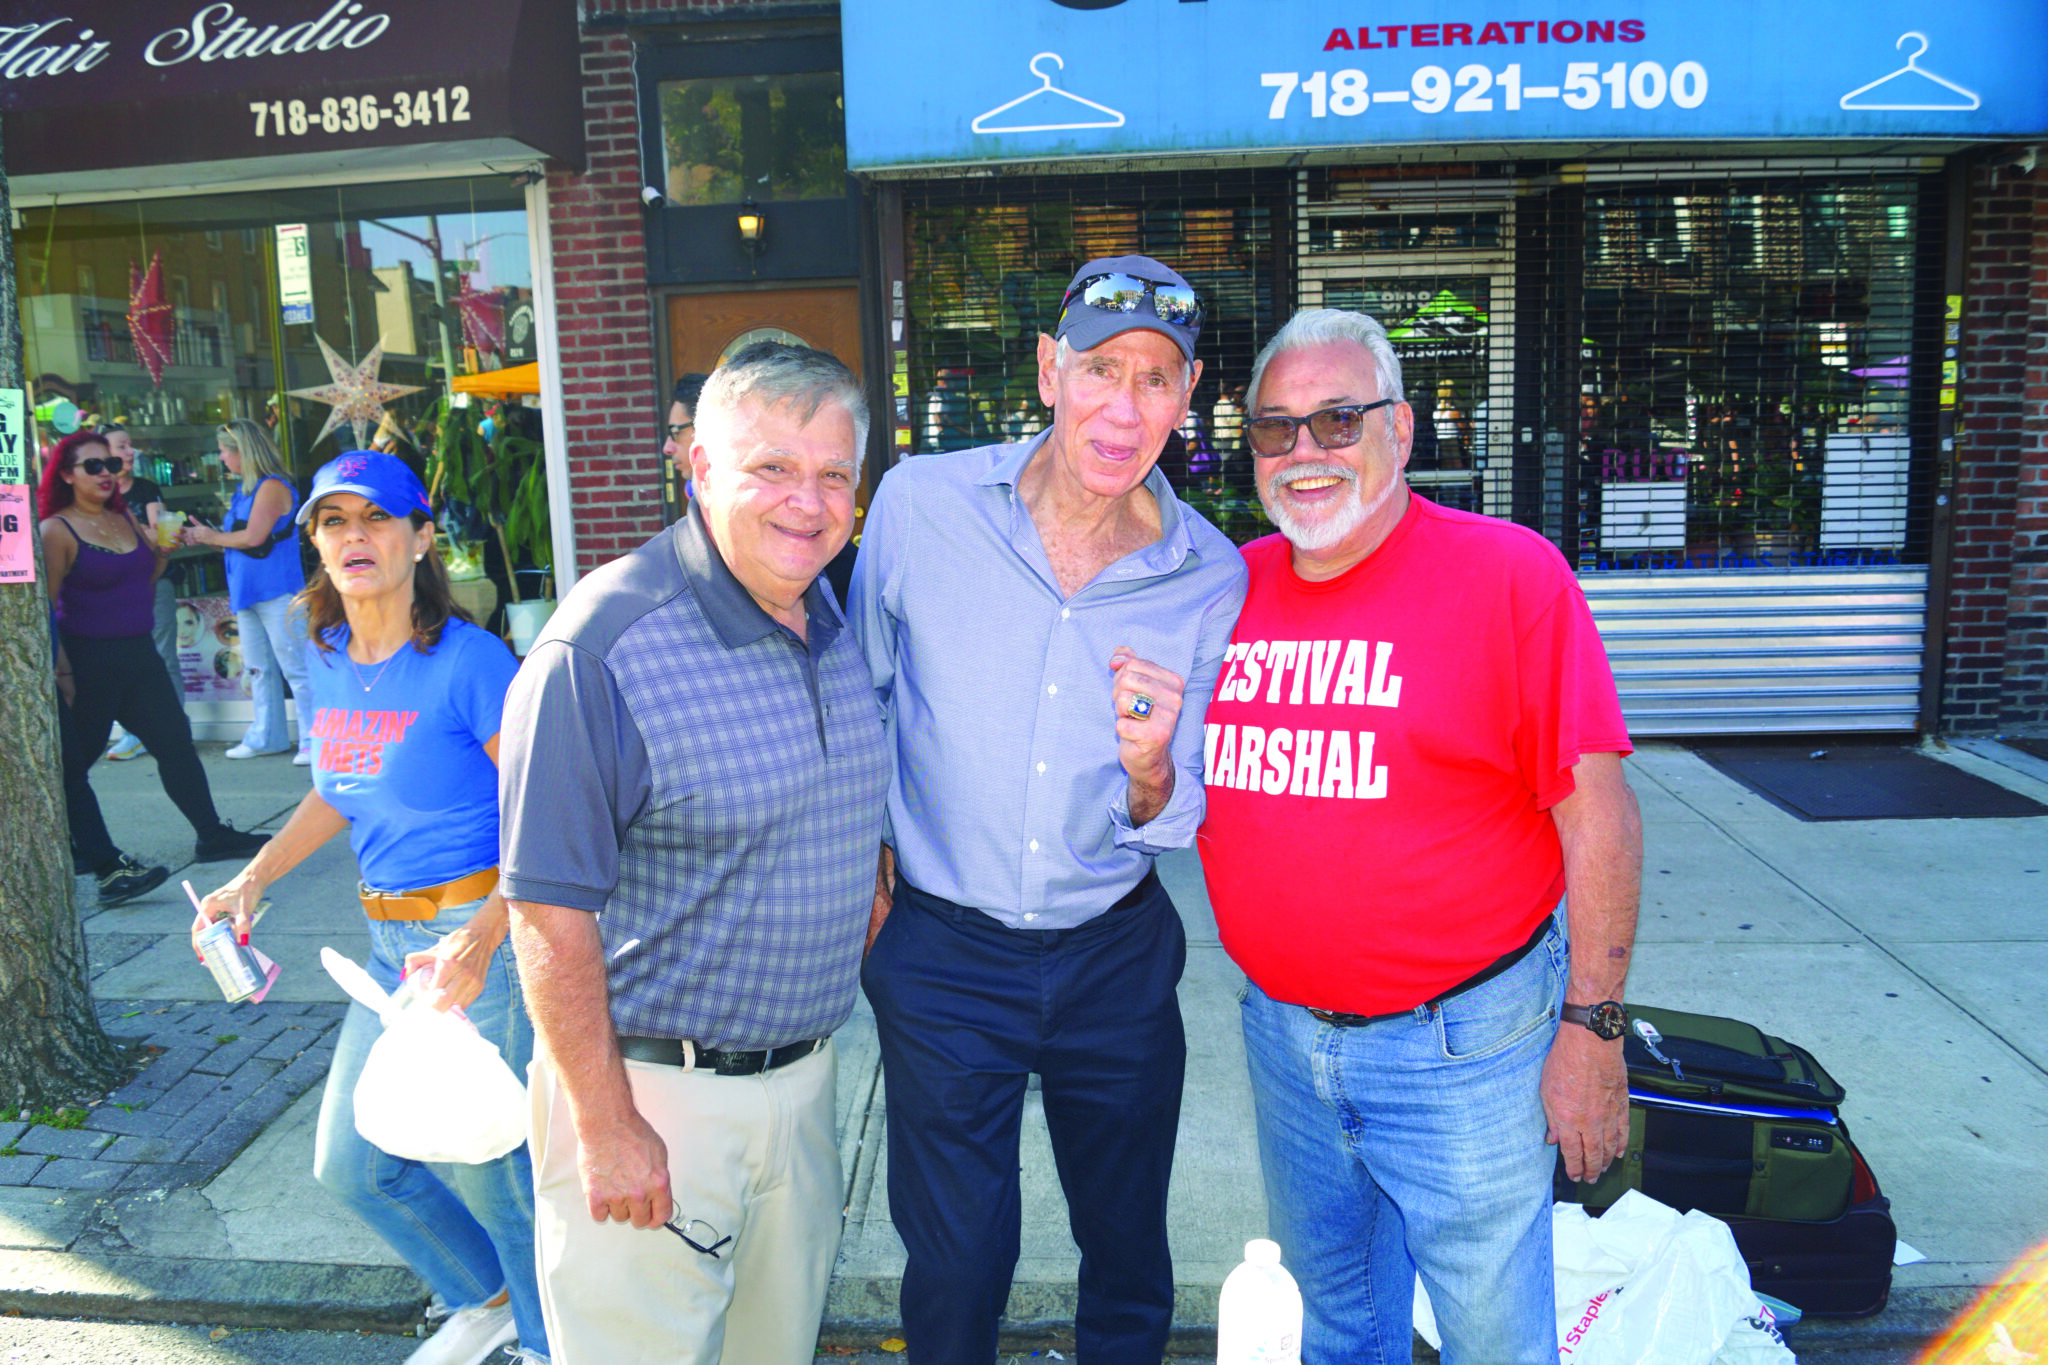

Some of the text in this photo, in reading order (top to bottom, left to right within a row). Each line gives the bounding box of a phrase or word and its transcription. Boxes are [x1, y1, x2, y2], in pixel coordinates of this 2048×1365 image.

[144, 0, 391, 66] Studio
[1323, 20, 1646, 51] ALTERATIONS
[249, 86, 471, 136] 718-836-3412
[1261, 61, 1708, 119] 718-921-5100
[1211, 640, 1402, 707] ESTIVAL
[309, 708, 419, 743] AMAZIN'
[317, 740, 384, 775] METS
[1566, 1289, 1612, 1346] Staple
